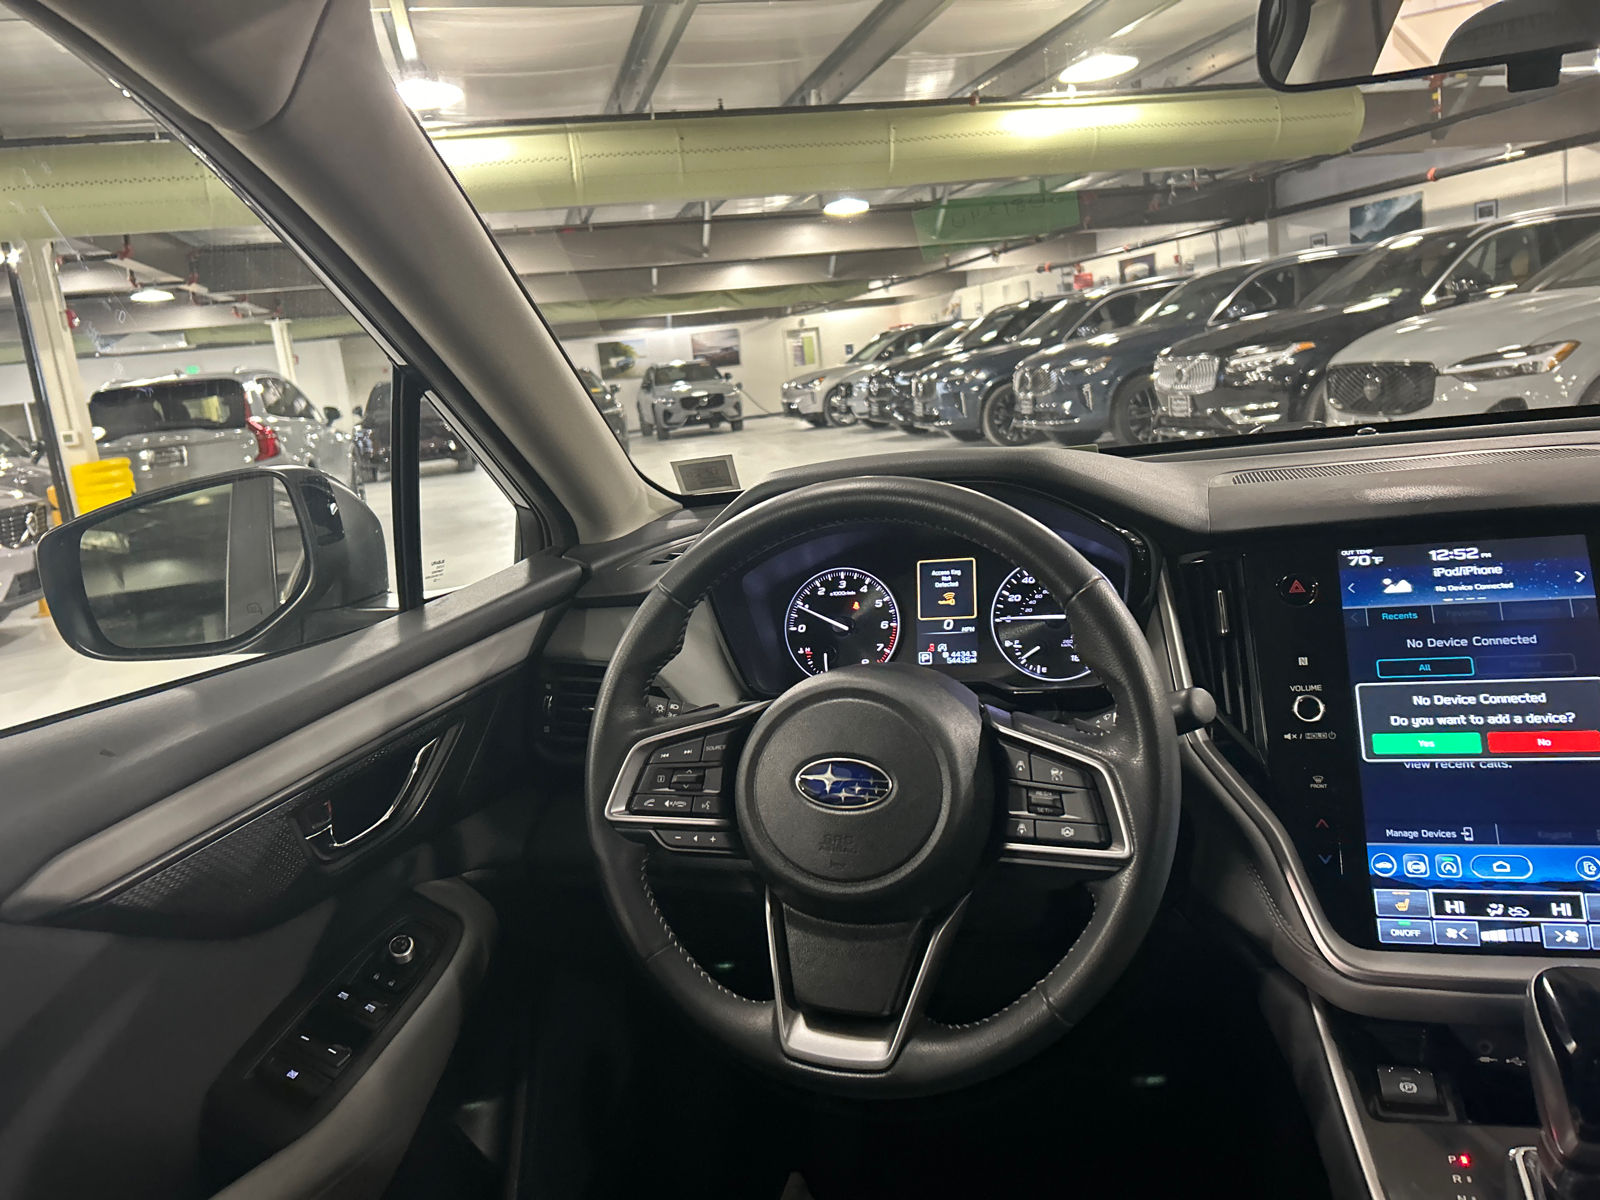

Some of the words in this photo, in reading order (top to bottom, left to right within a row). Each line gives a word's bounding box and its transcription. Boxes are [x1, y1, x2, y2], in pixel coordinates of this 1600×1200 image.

[1428, 548, 1479, 561] 12:52
[1433, 565, 1503, 577] iPod/iPhone
[1448, 583, 1473, 592] Device
[1474, 582, 1514, 590] Connected
[874, 599, 882, 608] 5
[1382, 612, 1418, 620] Recents
[798, 624, 806, 632] 0
[880, 621, 889, 629] 6
[944, 619, 954, 630] 0
[1407, 638, 1423, 648] No
[1427, 637, 1468, 647] Device
[1472, 635, 1537, 646] Connected
[876, 643, 884, 651] 7
[1419, 663, 1431, 672] All
[1413, 696, 1430, 705] No
[1434, 694, 1476, 704] Device
[1480, 693, 1546, 704] Connected
[1390, 716, 1409, 726] Do
[1411, 717, 1434, 728] you
[1437, 715, 1466, 725] want
[1469, 715, 1484, 724] to
[1487, 714, 1510, 724] add
[1526, 712, 1576, 723] device?
[1418, 739, 1434, 748] Yes
[1538, 738, 1551, 746] No
[1386, 829, 1418, 839] Manage
[1422, 829, 1457, 838] Devices
[1444, 900, 1465, 914] HI
[1551, 903, 1572, 916] HI
[1448, 1155, 1456, 1164] P
[1452, 1174, 1462, 1183] R
